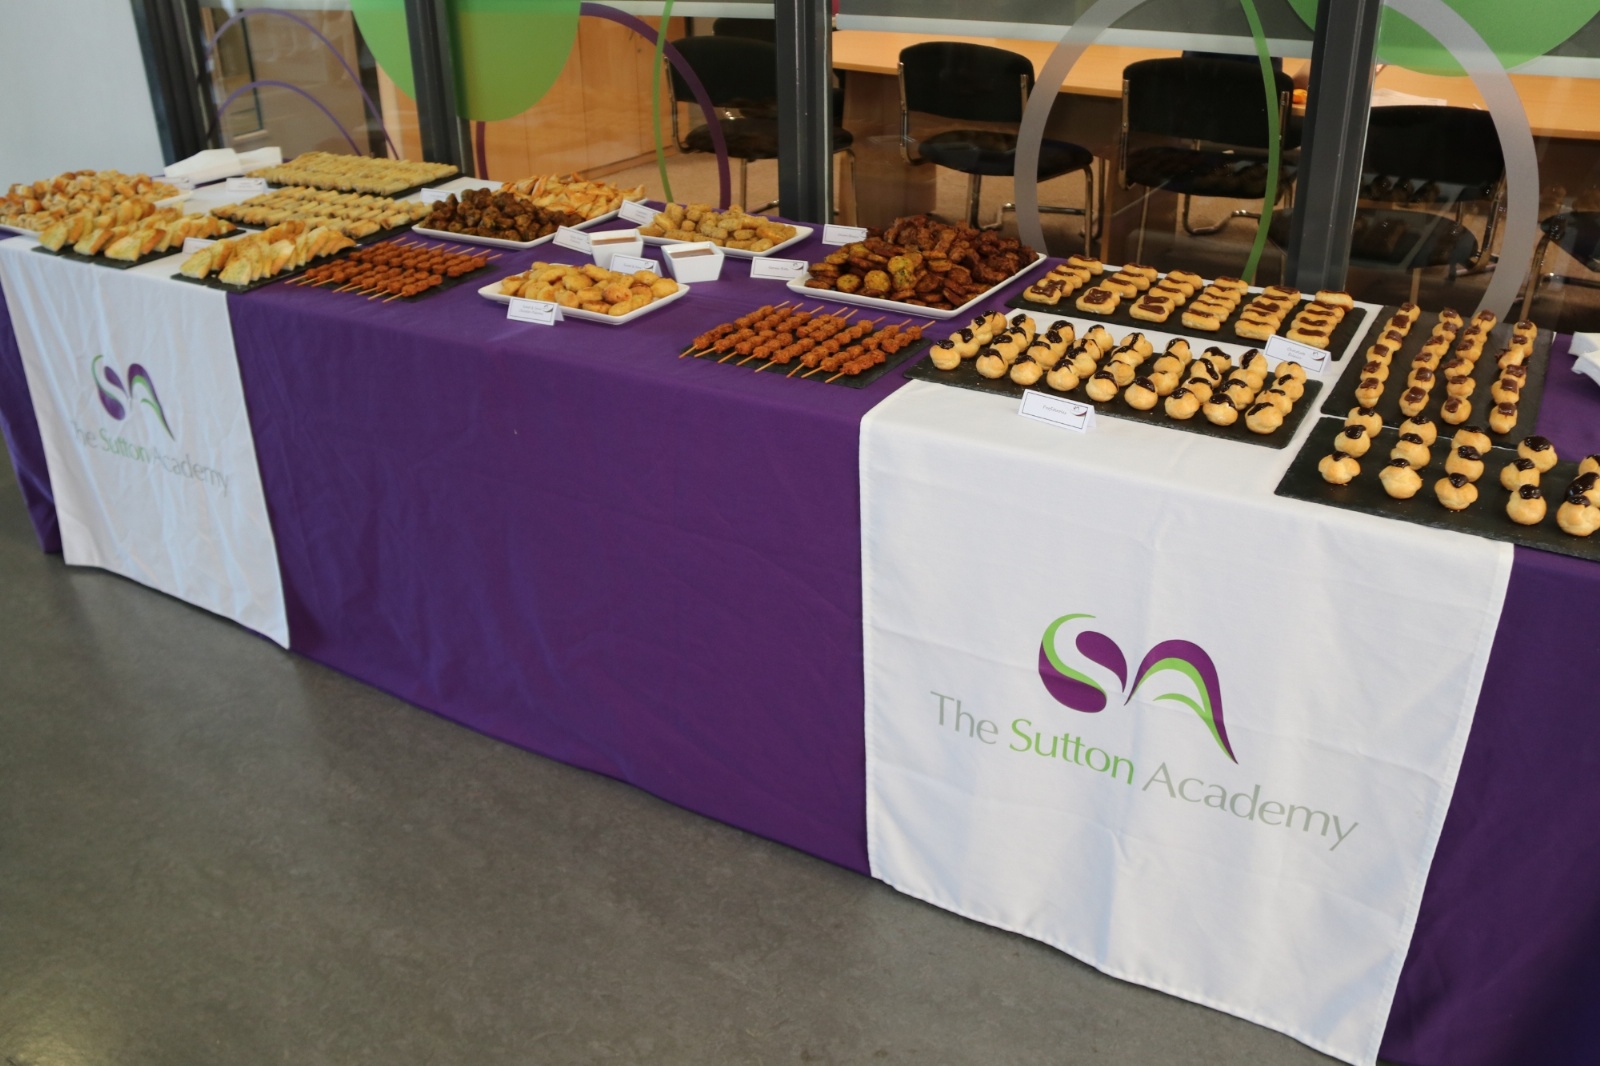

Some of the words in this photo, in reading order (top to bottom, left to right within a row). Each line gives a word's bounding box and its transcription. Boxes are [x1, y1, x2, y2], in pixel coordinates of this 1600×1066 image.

[99, 427, 151, 464] Sutton
[153, 446, 229, 497] Academy
[929, 690, 999, 746] The
[1009, 718, 1135, 786] Sutton
[1141, 761, 1359, 852] Academy
